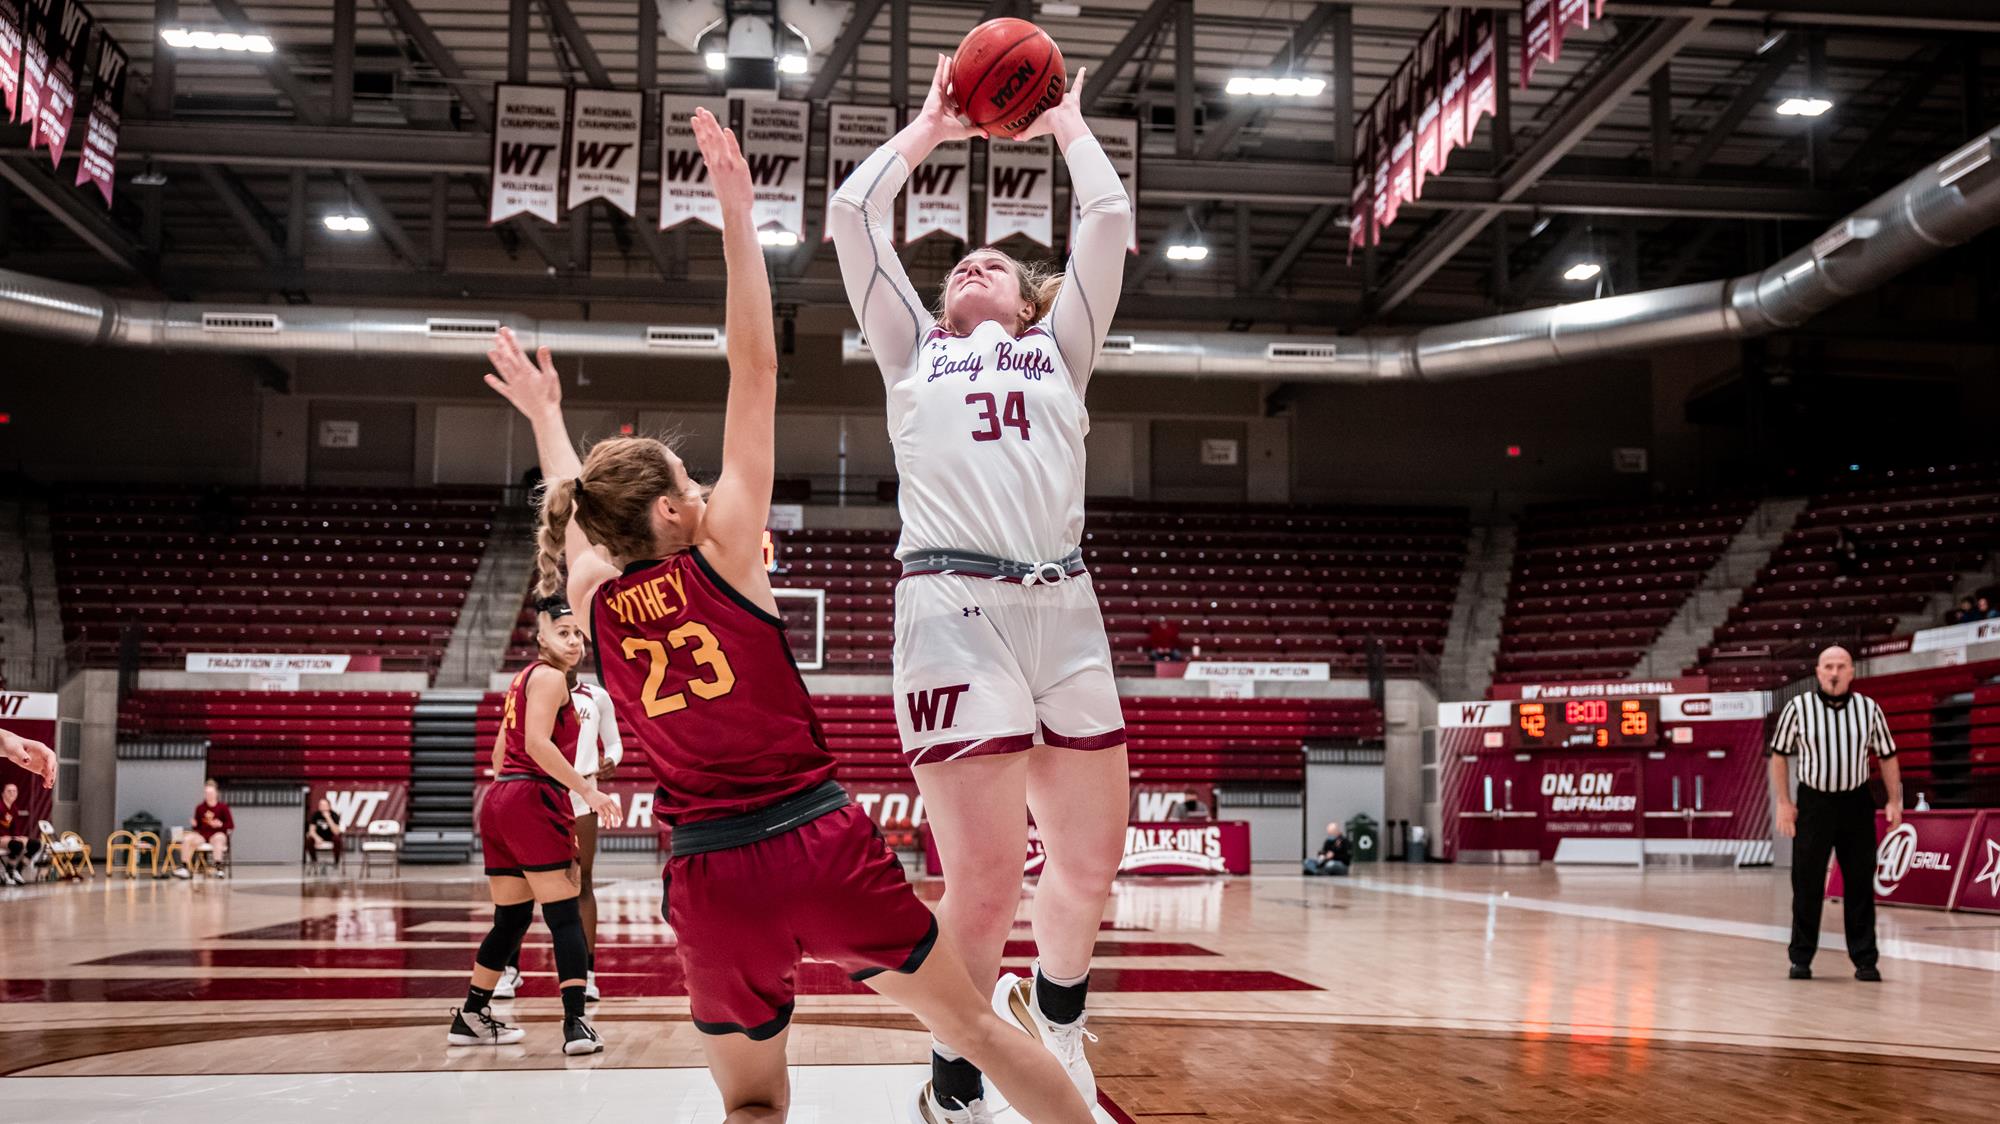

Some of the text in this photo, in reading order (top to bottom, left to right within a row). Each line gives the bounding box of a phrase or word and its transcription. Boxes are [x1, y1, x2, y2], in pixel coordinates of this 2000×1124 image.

[991, 59, 1036, 109] NCAA
[505, 103, 556, 117] NATIONAL
[583, 106, 633, 118] NATIONAL
[501, 117, 560, 131] CHAMPIONS
[578, 119, 637, 131] CHAMPIONS
[752, 117, 800, 129] NATIONAL
[838, 123, 888, 134] NATIONAL
[747, 131, 803, 142] CHAMPIONS
[501, 142, 557, 176] WT
[577, 141, 634, 169] WT
[992, 144, 1049, 155] CHAMPIONS
[748, 153, 800, 187] WT
[912, 164, 966, 195] WT
[993, 166, 1047, 199] WT
[669, 188, 715, 199] VOLLEYBAL
[927, 342, 1055, 382] Lady Buffs
[965, 391, 1031, 442] 34
[207, 657, 271, 669] TRADITION
[287, 659, 333, 670] MOTION
[621, 621, 736, 718] 23
[1542, 686, 1569, 698] LADY
[1570, 685, 1604, 696] BUFFS
[1606, 682, 1674, 695] BASKETBALL
[907, 684, 970, 732] WT
[1462, 705, 1491, 723] WT
[1566, 701, 1608, 724] 8:00
[1520, 715, 1545, 737] 42
[1621, 711, 1647, 735] 28
[1597, 729, 1608, 747] 3
[326, 791, 390, 829] WT
[1552, 796, 1637, 812] BUFFALOES!
[1911, 851, 1952, 871] GRILL
